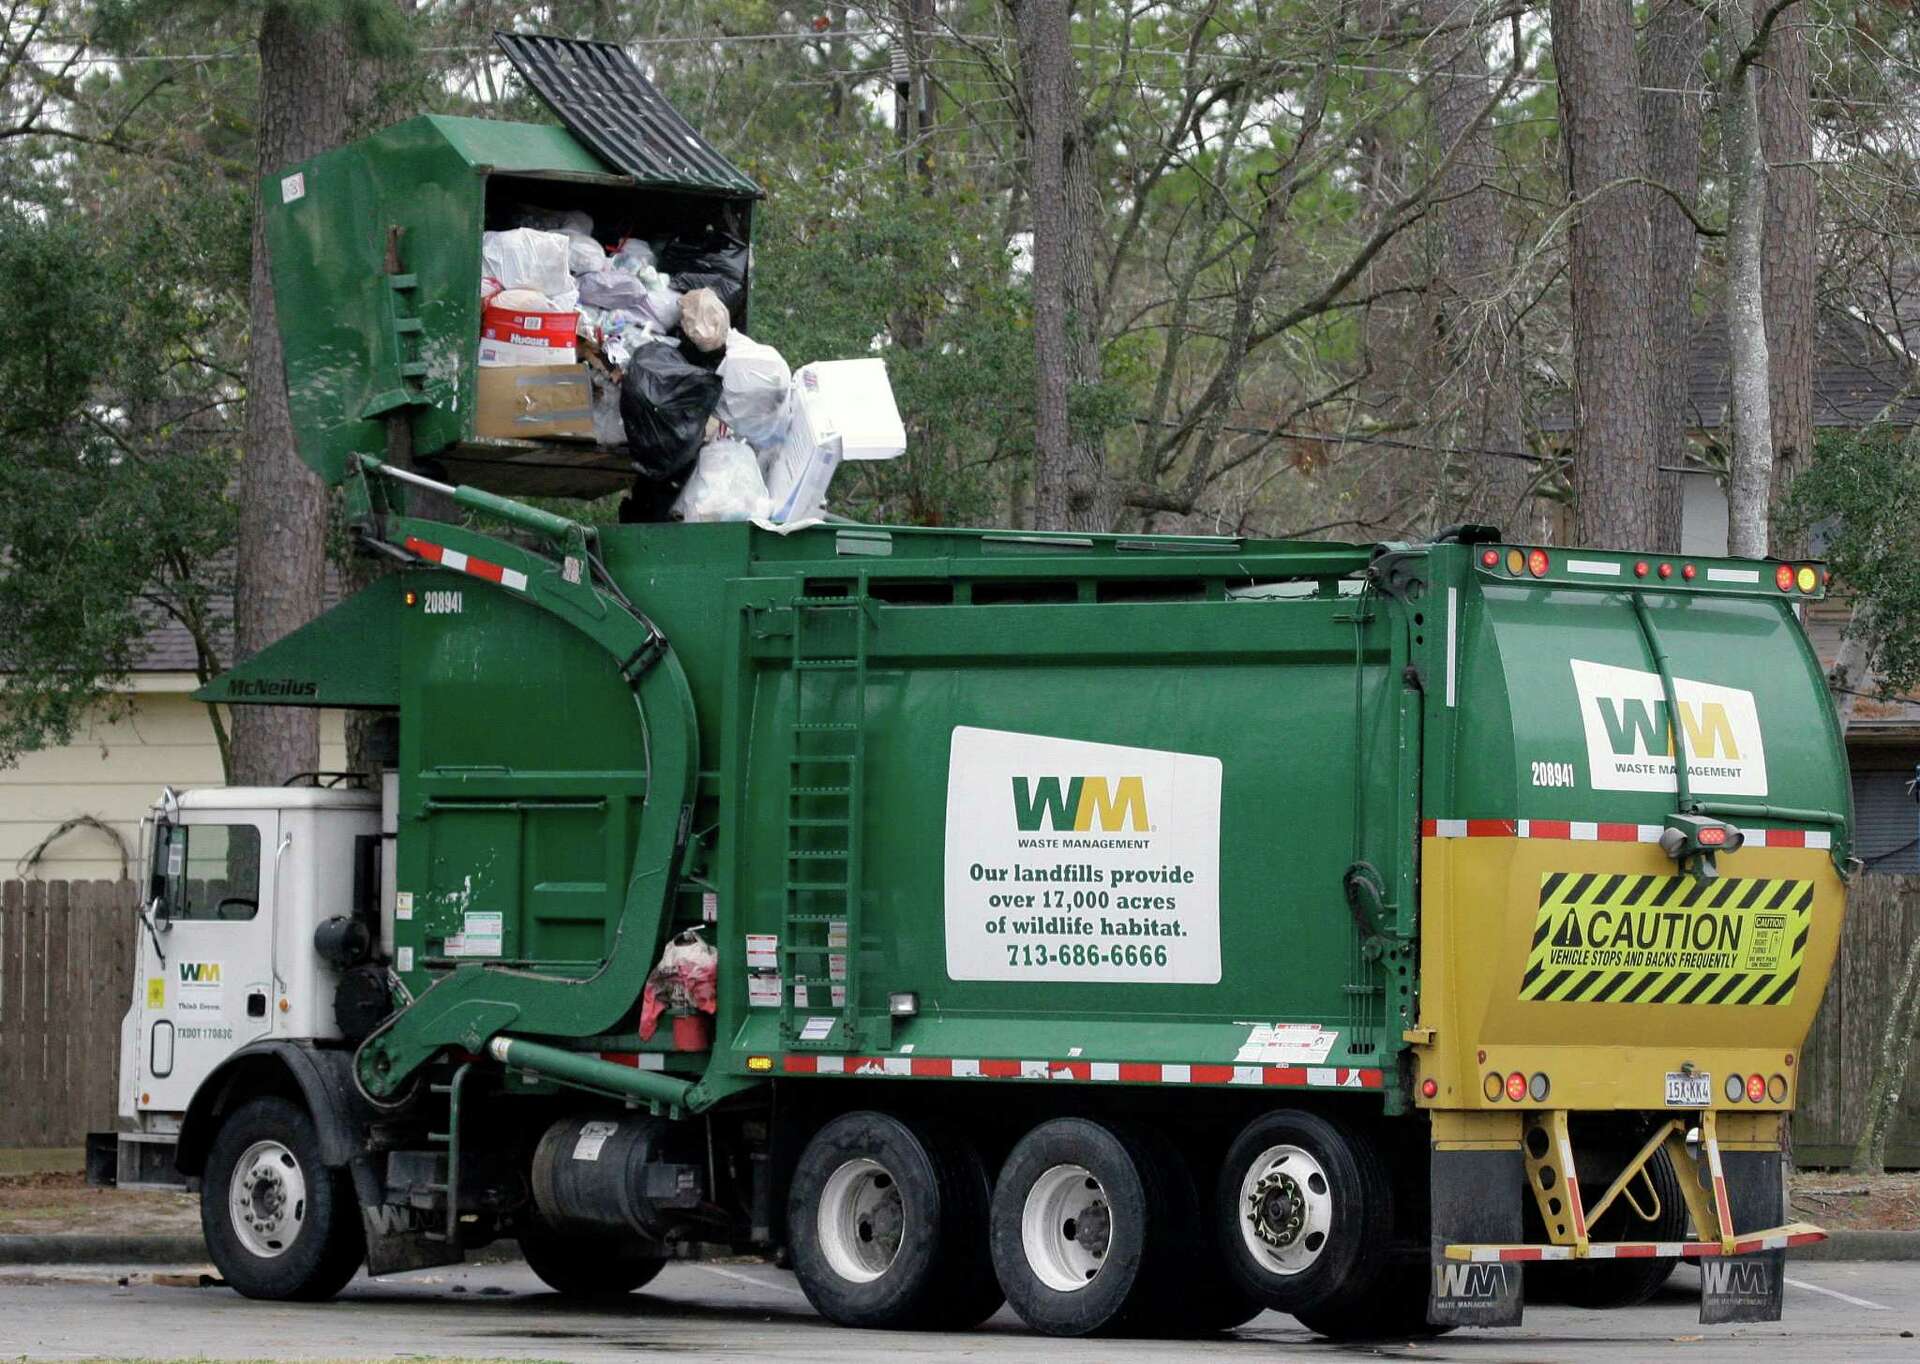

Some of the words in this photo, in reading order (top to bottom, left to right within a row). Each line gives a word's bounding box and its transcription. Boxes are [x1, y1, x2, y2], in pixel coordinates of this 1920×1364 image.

[424, 591, 462, 614] 208941
[228, 679, 317, 697] McNeilus
[1596, 697, 1740, 760] WM
[1531, 761, 1575, 788] 208941
[1615, 763, 1655, 774] WASTE
[1658, 763, 1742, 778] MAAGEMENT
[1011, 776, 1151, 832] WM
[1017, 838, 1060, 849] WASTE
[1062, 839, 1150, 850] MANAGEMENT
[970, 863, 1008, 881] Our
[1014, 864, 1104, 883] landfills
[1110, 865, 1194, 888] provide
[989, 894, 1035, 908] over
[1043, 891, 1109, 912] 17,000
[1116, 896, 1176, 910] acres
[985, 916, 1007, 934] of
[1012, 917, 1093, 935] wildlife
[1100, 918, 1188, 937] habitat.
[1587, 910, 1743, 951] CAUTION
[1755, 917, 1784, 929] CAUTION
[1007, 944, 1168, 967] 713-686-6666
[1550, 950, 1590, 965] VEHICLE
[1591, 950, 1621, 966] STOPS
[1623, 951, 1643, 967] AND
[1645, 951, 1677, 968] BACKS
[1679, 952, 1738, 970] FREQUENTLY
[180, 963, 220, 981] WM
[177, 1028, 200, 1039] TXDOT
[1436, 1263, 1508, 1297] WM
[1704, 1262, 1768, 1295] WM
